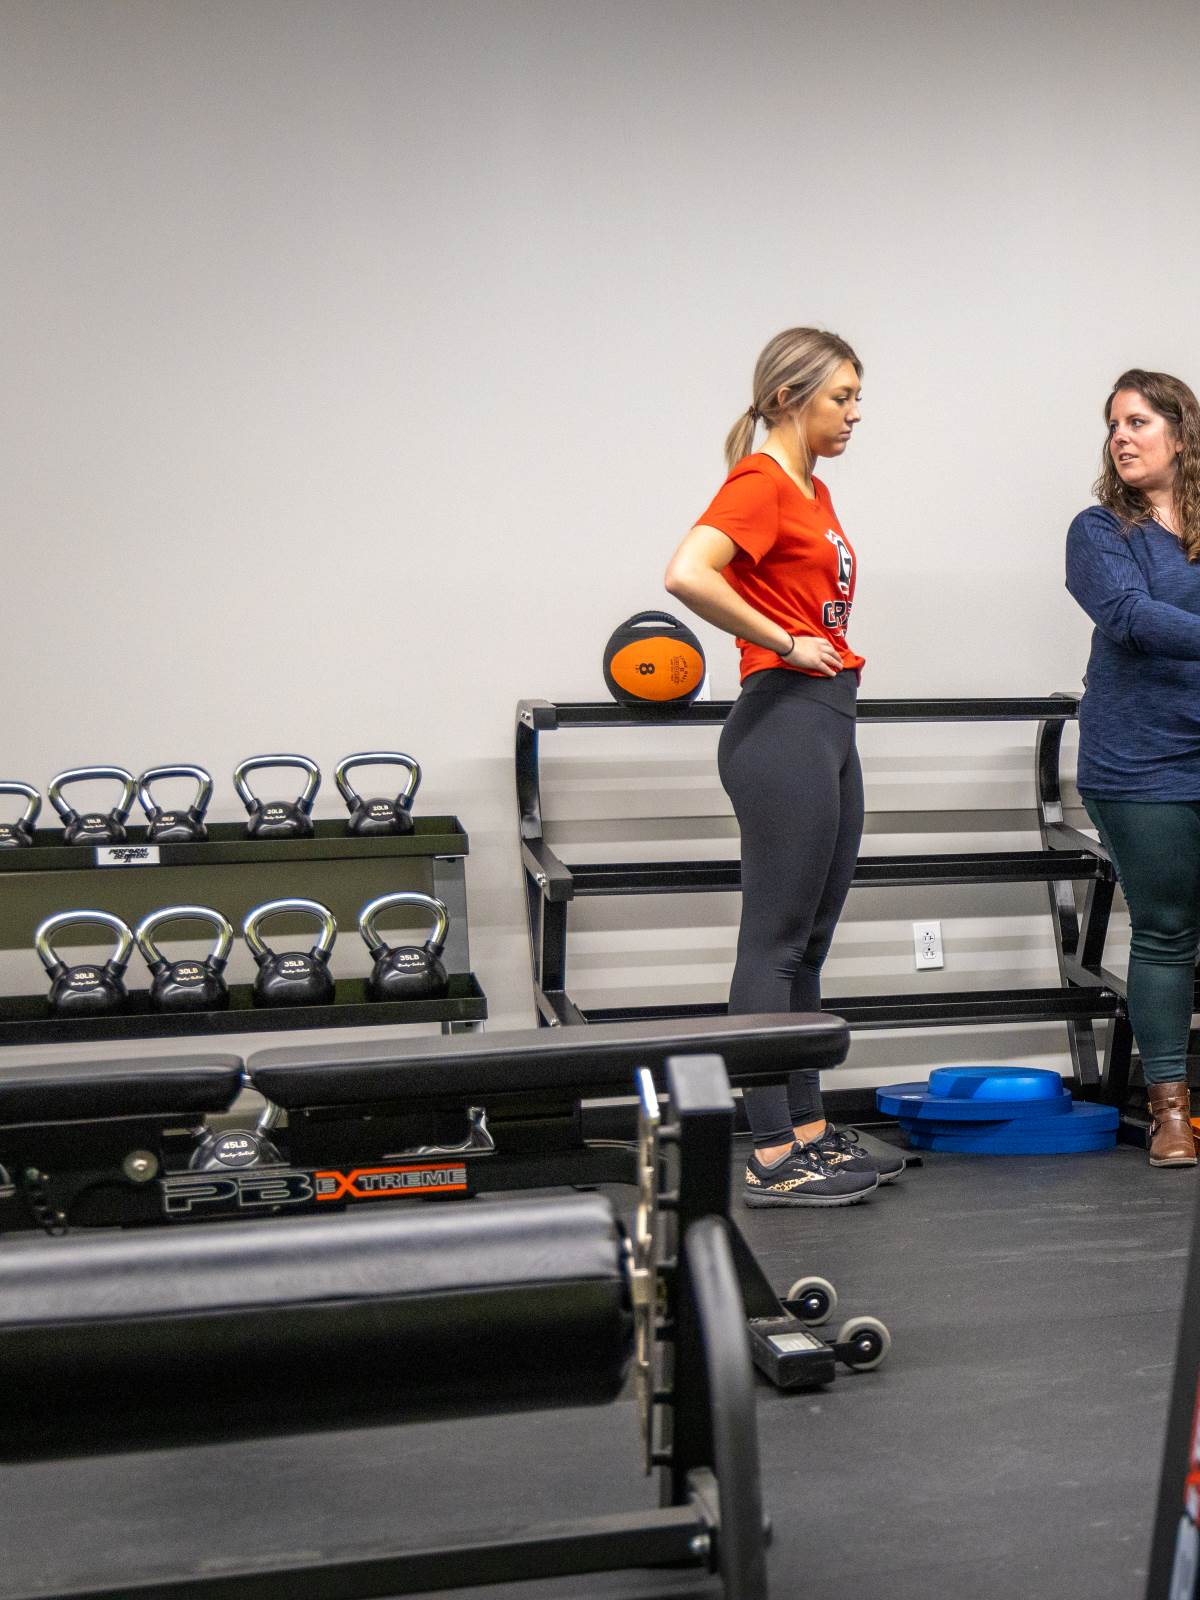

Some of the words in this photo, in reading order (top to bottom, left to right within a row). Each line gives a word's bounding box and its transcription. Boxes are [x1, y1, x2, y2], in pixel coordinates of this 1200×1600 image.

[639, 662, 656, 676] 8
[284, 960, 305, 968] 35LB
[74, 972, 95, 980] 30LB
[178, 967, 198, 976] 30LB
[223, 1140, 248, 1150] 45LB
[315, 1163, 467, 1201] EXTREME
